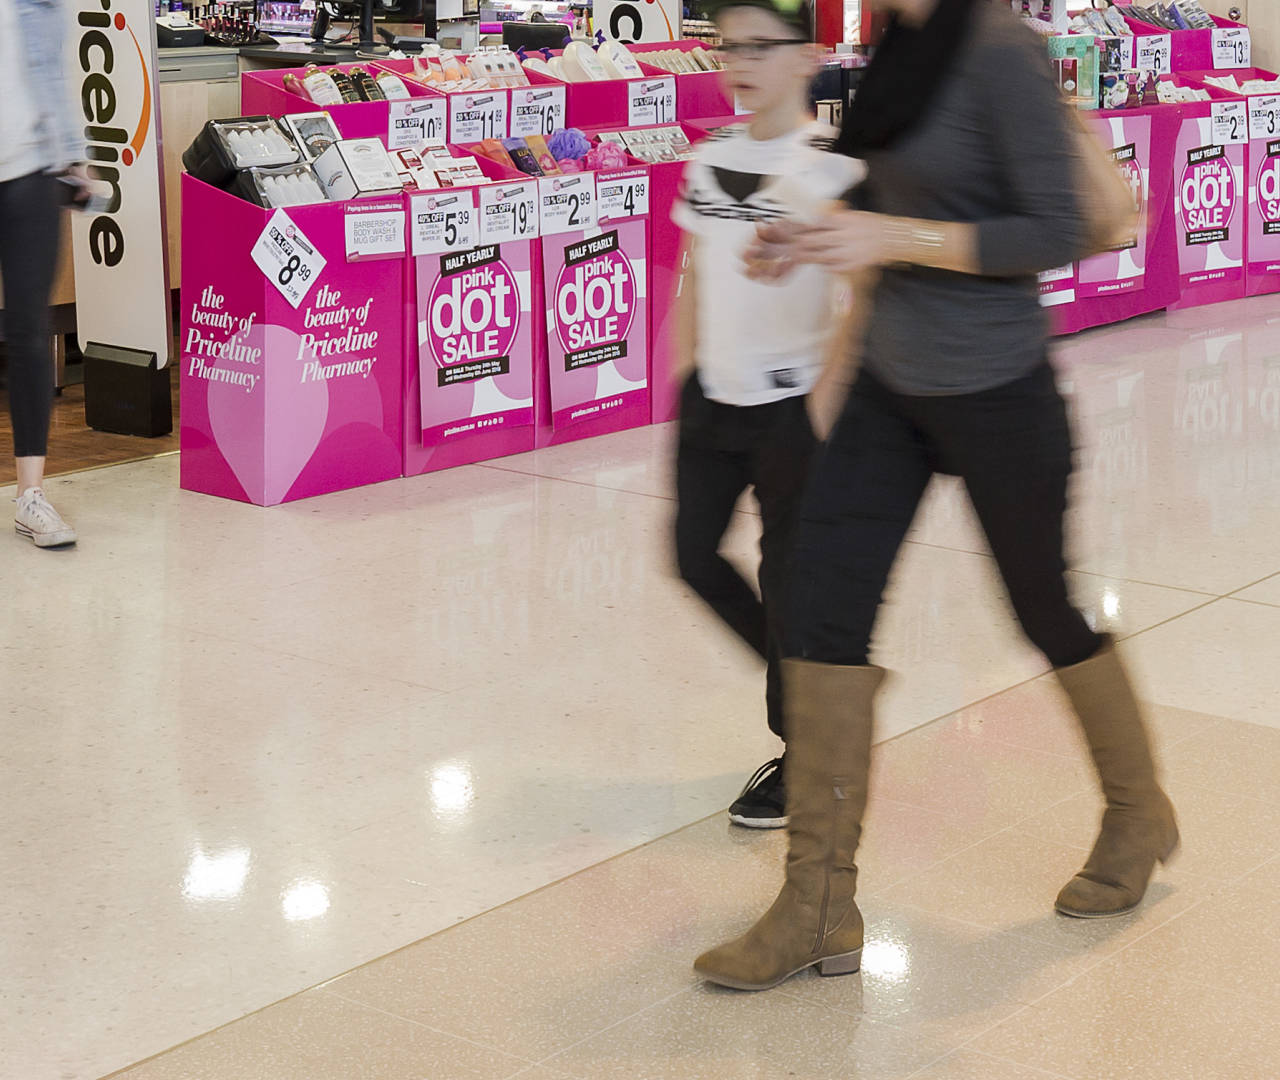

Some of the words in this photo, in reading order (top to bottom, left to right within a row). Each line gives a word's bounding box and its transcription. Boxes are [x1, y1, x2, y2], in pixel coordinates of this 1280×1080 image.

[1200, 161, 1221, 179] pink
[624, 185, 634, 216] 4
[635, 184, 645, 197] 99
[1182, 167, 1231, 211] dot
[431, 212, 444, 223] OFF
[499, 202, 511, 214] OFF
[512, 202, 527, 235] 19
[568, 194, 579, 225] 2
[580, 192, 591, 204] 99
[1188, 207, 1223, 230] SALE
[444, 213, 457, 246] 5
[458, 210, 469, 224] 39
[445, 255, 467, 270] HALF
[467, 246, 495, 265] YEARLY
[569, 247, 587, 261] HALF
[587, 236, 614, 255] YEARLY
[278, 254, 301, 286] 8
[298, 264, 311, 281] 99
[462, 268, 495, 293] pink
[584, 256, 614, 283] pink
[201, 285, 225, 310] the
[315, 284, 342, 310] the
[431, 275, 511, 338] dot
[558, 263, 629, 326] dot
[191, 303, 238, 336] beauty
[238, 311, 257, 338] of
[304, 307, 355, 330] beauty
[355, 297, 373, 326] of
[184, 327, 262, 365] Priceline
[296, 326, 379, 361] Priceline
[442, 329, 499, 364] SALE
[568, 316, 619, 350] SALE
[188, 357, 261, 393] Pharmacy
[300, 356, 377, 385] Pharmacy
